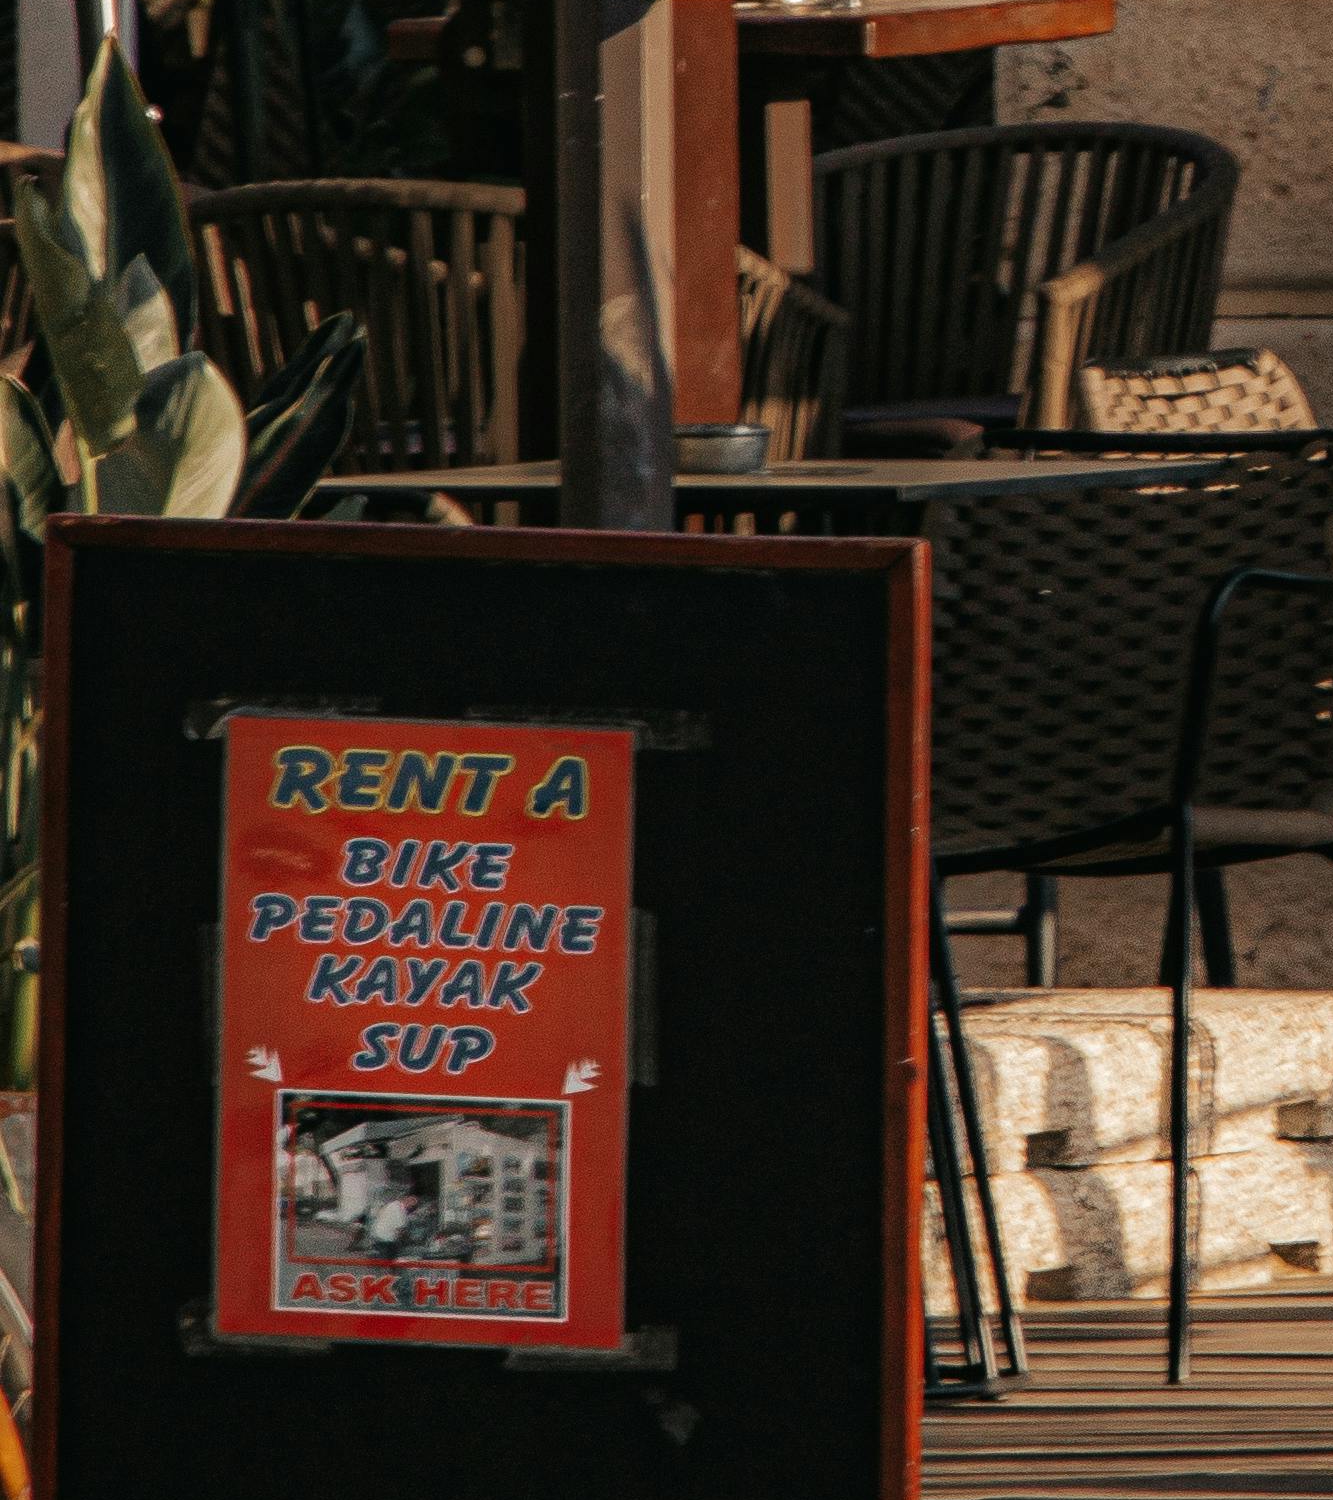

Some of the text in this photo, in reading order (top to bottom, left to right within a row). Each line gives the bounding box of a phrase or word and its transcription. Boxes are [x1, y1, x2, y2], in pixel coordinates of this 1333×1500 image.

[271, 744, 590, 821] RENT A
[339, 836, 517, 894] BIKE
[248, 892, 603, 956] PEDALINE
[306, 953, 544, 1014] KAYAK
[351, 1022, 495, 1076] SUP
[290, 1271, 557, 1312] ASK HERE
